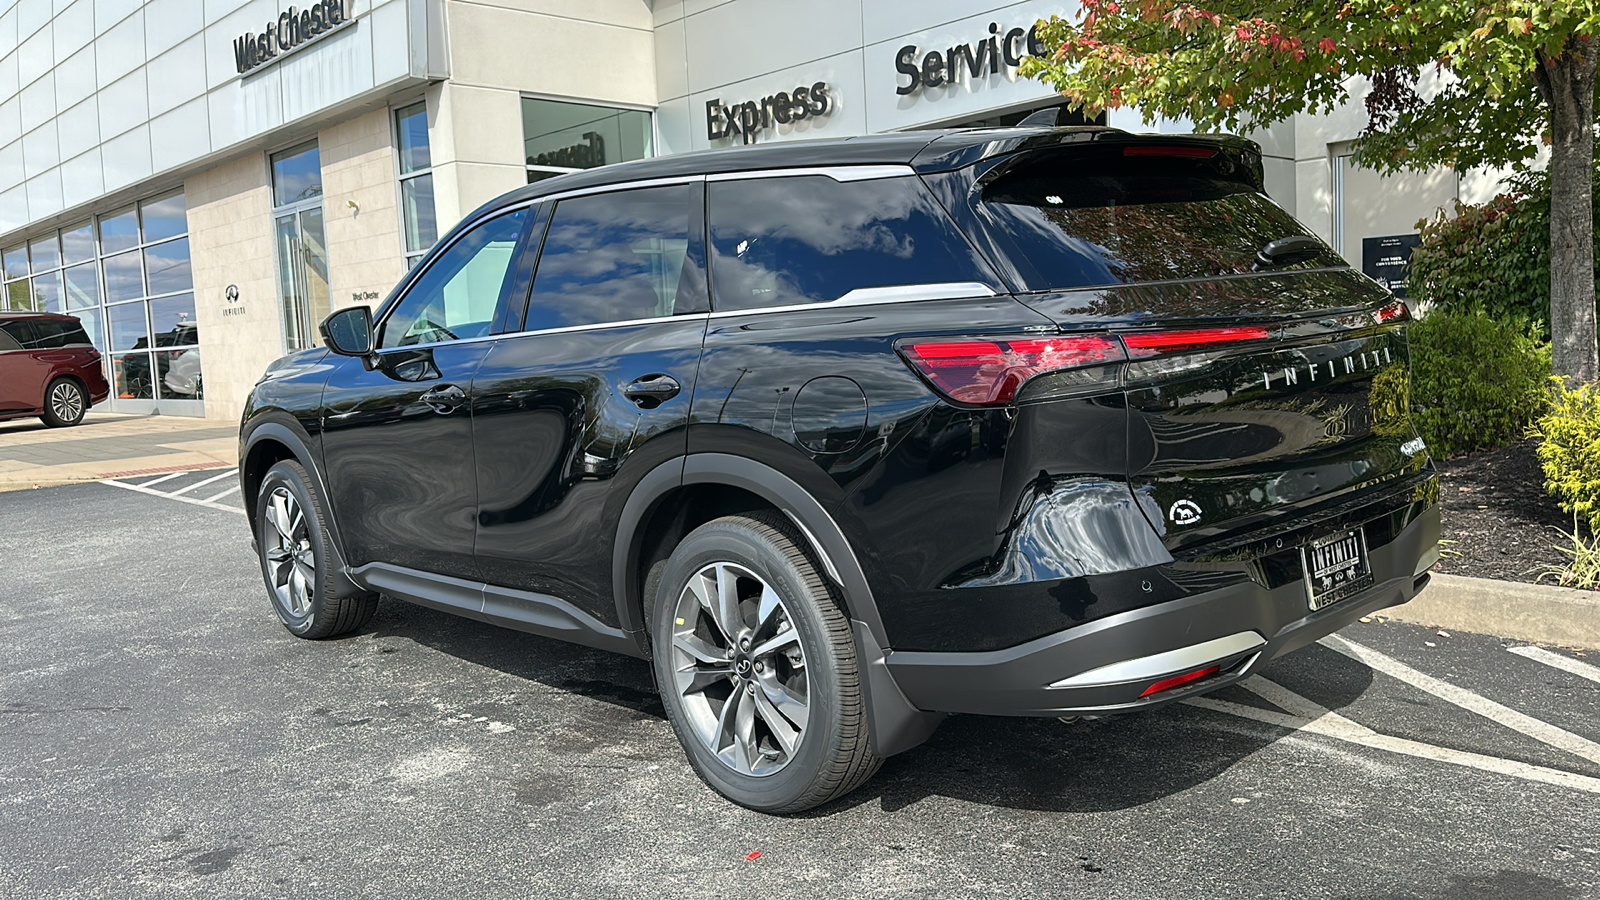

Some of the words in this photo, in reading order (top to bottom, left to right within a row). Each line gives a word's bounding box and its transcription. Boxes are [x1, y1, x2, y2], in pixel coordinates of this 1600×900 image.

[232, 21, 277, 74] West
[895, 22, 1048, 96] Service
[705, 81, 829, 145] Express
[1263, 347, 1391, 390] INFINITI
[1311, 537, 1359, 572] INFINITI
[1313, 591, 1337, 609] WEST
[1337, 578, 1373, 599] CHESTER
